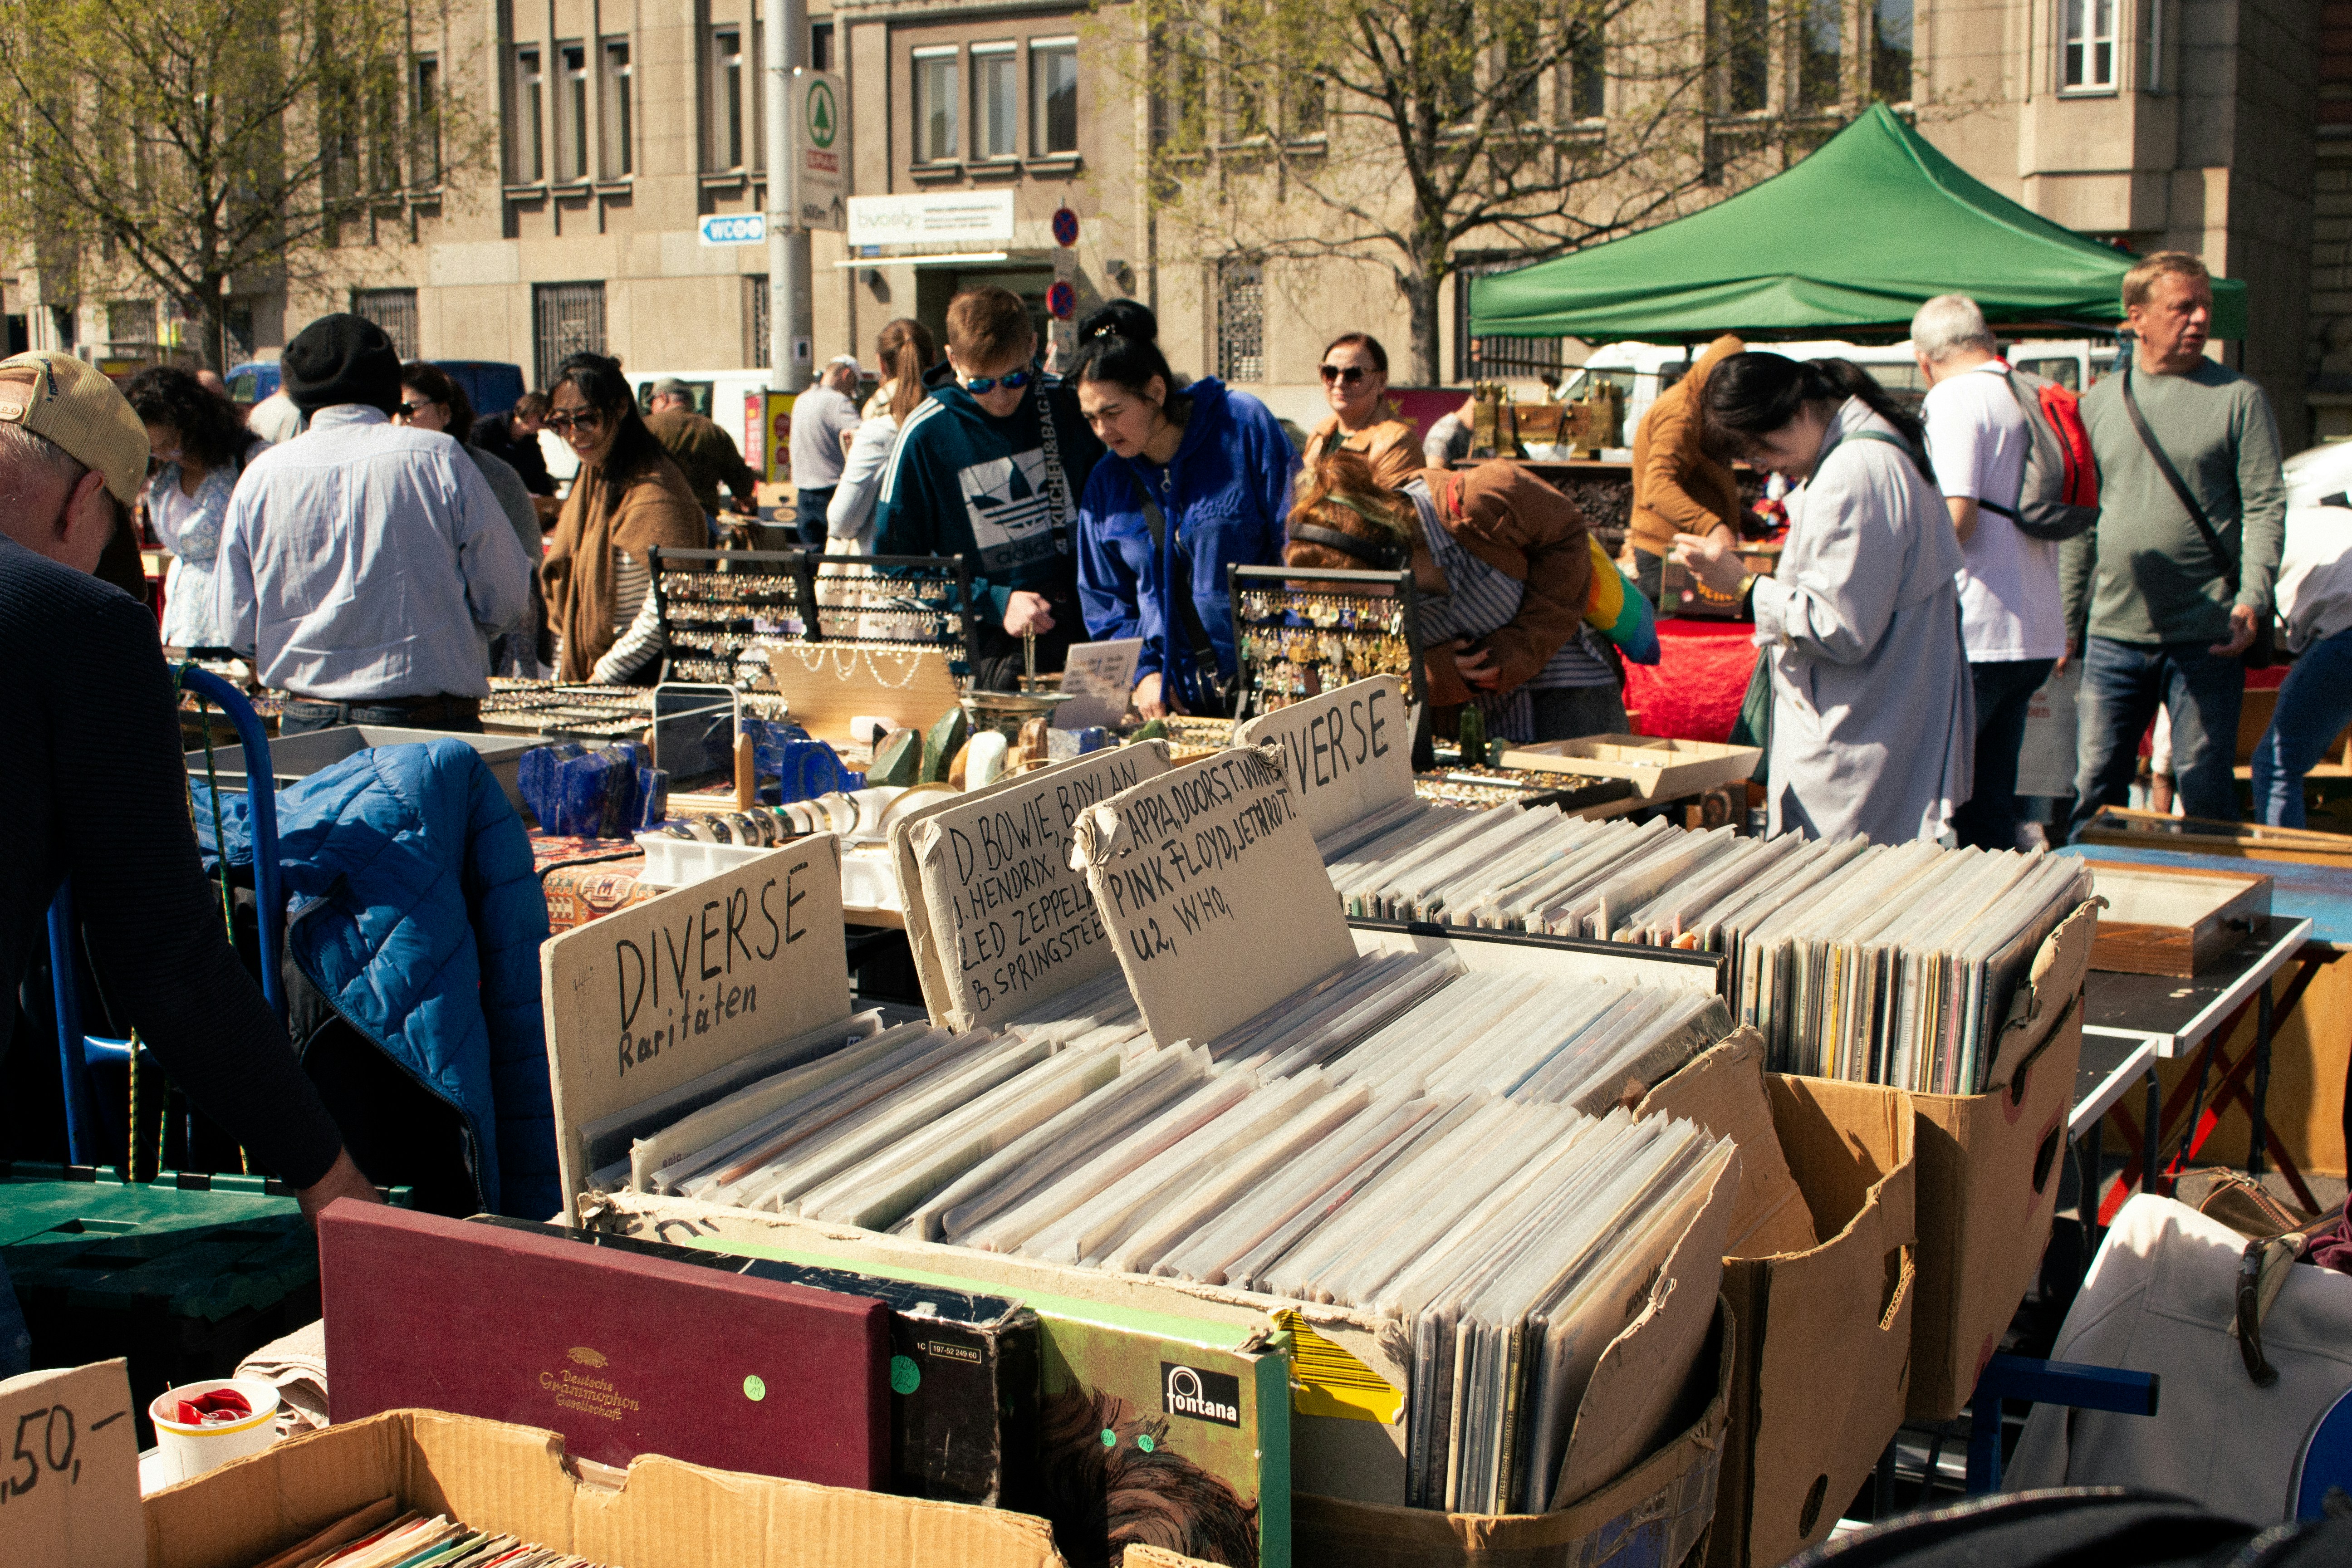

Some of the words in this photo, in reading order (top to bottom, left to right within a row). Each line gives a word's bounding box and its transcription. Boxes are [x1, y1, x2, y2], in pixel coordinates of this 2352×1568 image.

[1108, 855, 1174, 918] PINK
[616, 861, 809, 1032] DIVERSE
[960, 921, 1006, 971] LED
[618, 980, 758, 1078] Raritäten
[916, 1342, 926, 1350] 1C
[933, 1345, 954, 1355] 197-52
[955, 1349, 967, 1357] 249
[969, 1351, 977, 1359] 60
[539, 1372, 639, 1411] Grammophon
[560, 1370, 613, 1392] Deutsche
[1166, 1366, 1237, 1422] fontana
[555, 1393, 622, 1421] Gesellschaft
[1411, 1471, 1419, 1501] ANGELES
[1499, 1458, 1510, 1500] ORCHESTRA
